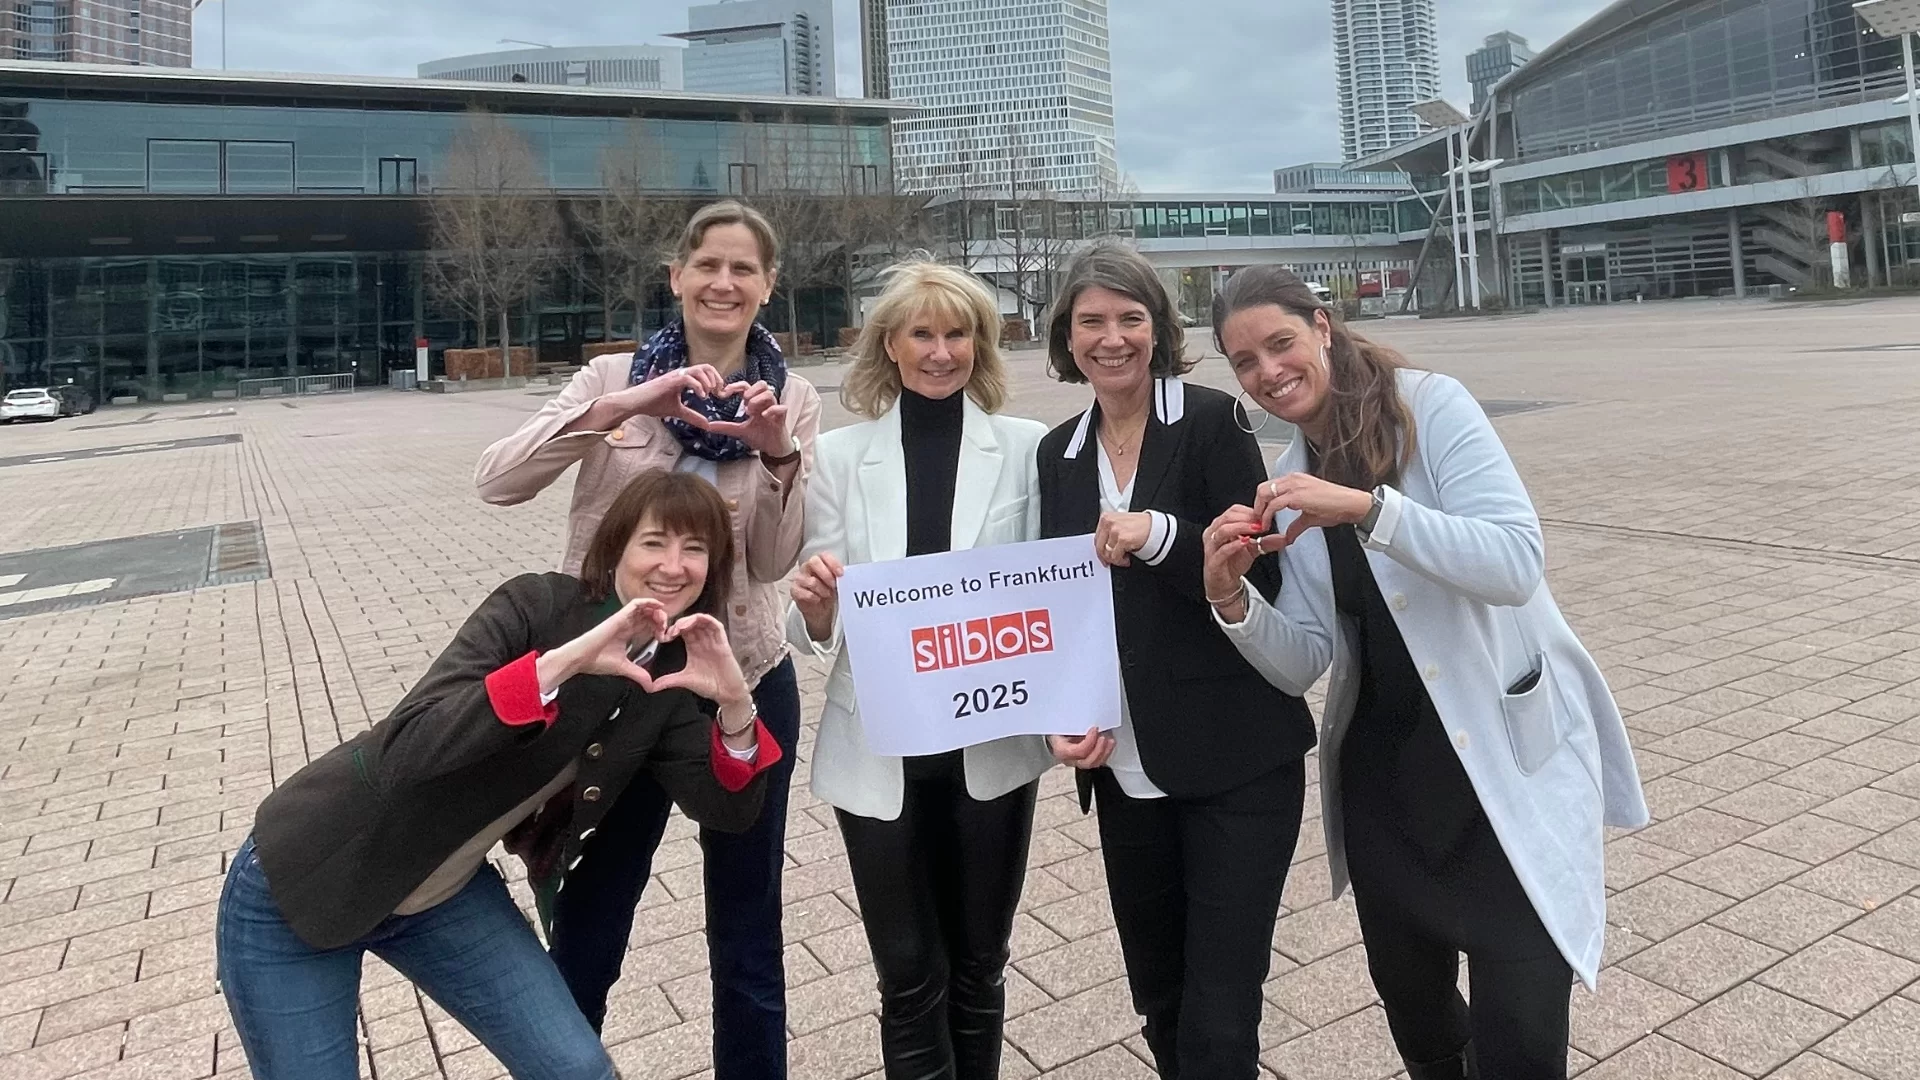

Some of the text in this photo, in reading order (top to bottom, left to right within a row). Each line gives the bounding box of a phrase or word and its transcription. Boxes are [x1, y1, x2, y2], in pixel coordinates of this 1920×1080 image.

[1678, 156, 1697, 190] 3
[854, 561, 1095, 609] Welcome to Frankfurt!
[914, 619, 1050, 669] sibos
[952, 680, 1029, 719] 2025
